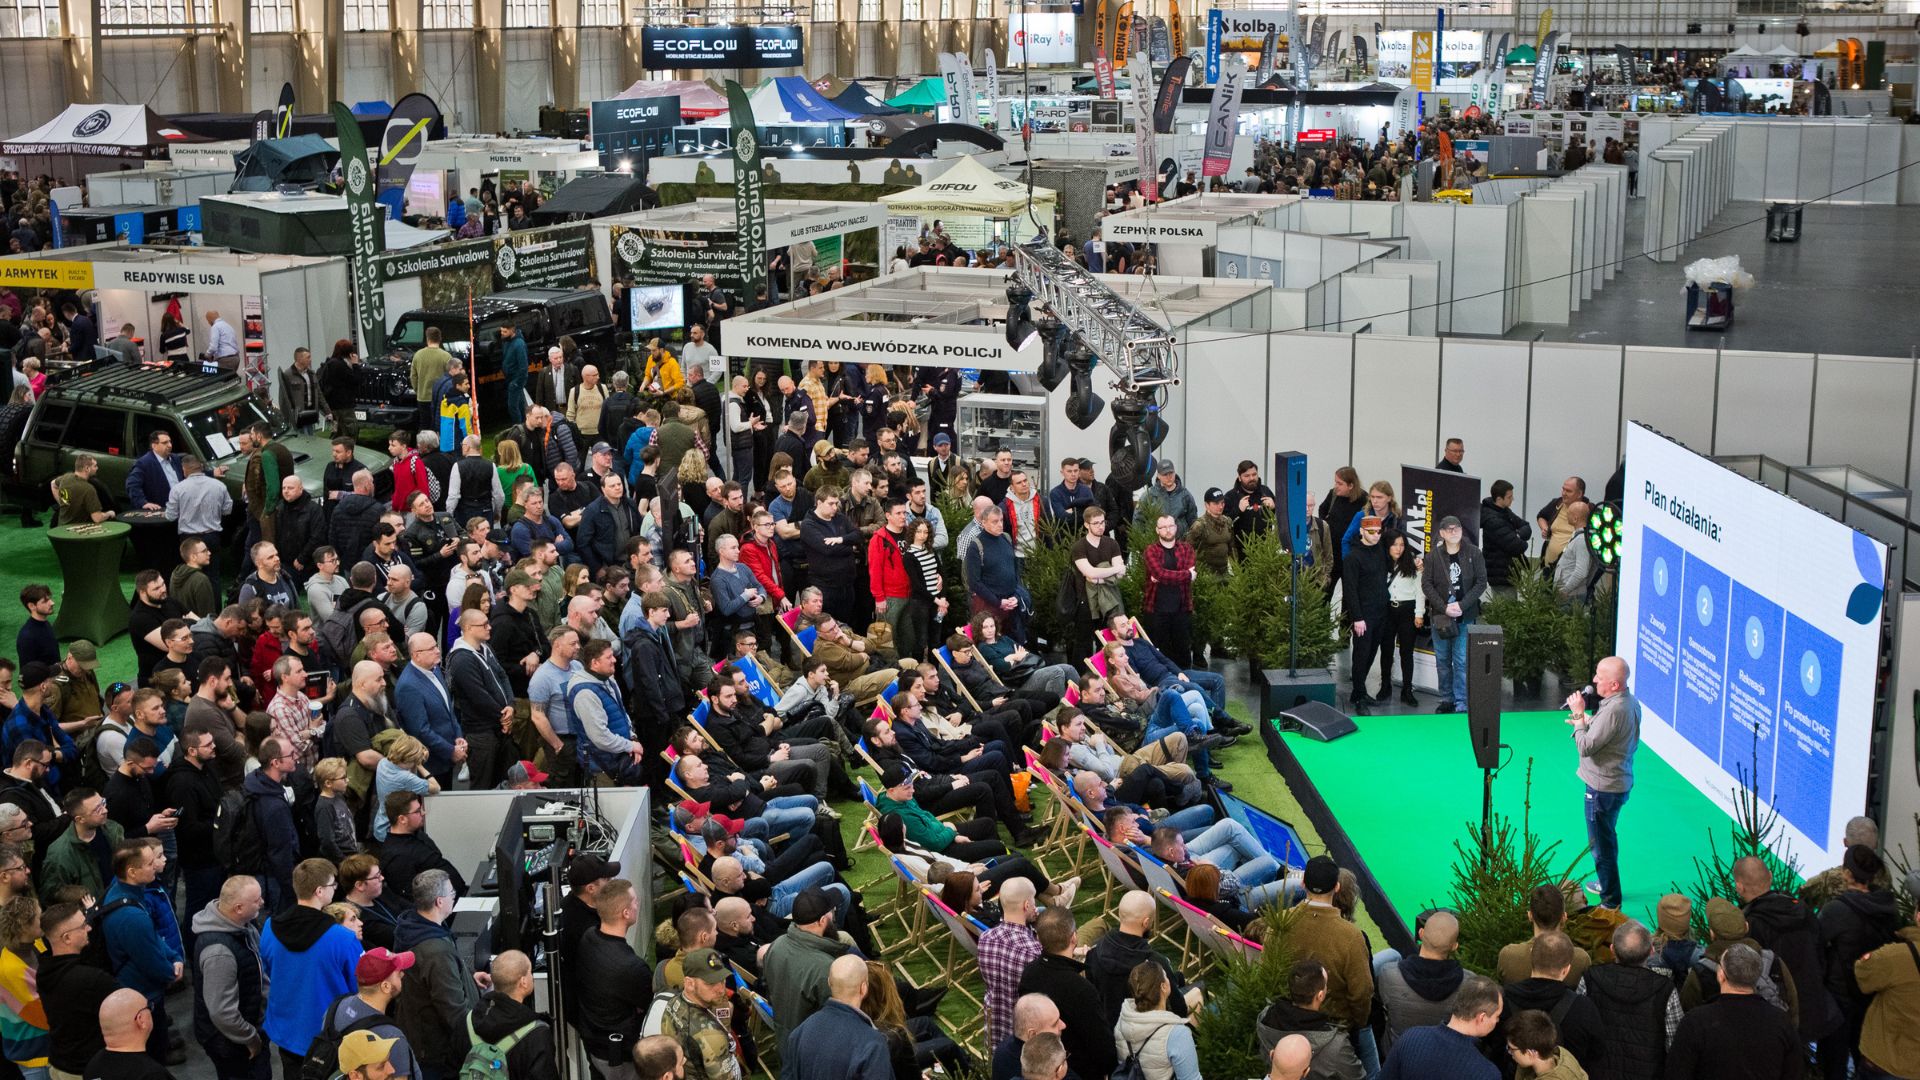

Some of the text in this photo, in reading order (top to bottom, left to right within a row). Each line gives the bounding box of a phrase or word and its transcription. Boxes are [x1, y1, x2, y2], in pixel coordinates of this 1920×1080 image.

[1233, 19, 1288, 33] kolba.pl
[653, 39, 737, 51] ECOFLOW
[755, 38, 798, 51] ECOFLOW
[1029, 34, 1052, 46] iRay
[616, 106, 659, 119] ECOFLOW
[1035, 110, 1067, 118] PARD
[1399, 98, 1409, 130] ubertus
[97, 147, 121, 155] POMOC
[489, 155, 523, 163] HUBSTER
[929, 183, 978, 191] DIFOU
[790, 215, 869, 237] KLUB STRZELAJĄCYCH INACZEJ
[1113, 226, 1204, 237] ZEPHYR POLSKA
[397, 249, 490, 274] Szkolenia Survivalowe
[519, 247, 586, 268] Szkolenia Survivalowe
[650, 248, 696, 259] Szkolenia
[697, 250, 739, 261] Survivalo
[650, 261, 683, 269] Zajmujemy
[693, 261, 727, 270] szkoleniami
[5, 267, 58, 280] ARMYTEK
[124, 271, 225, 286] READYWISE USA
[747, 336, 1002, 359] KOMENDA WOJEWÓDZKA POLICJI
[1424, 489, 1434, 533] libertate
[1644, 479, 1723, 543] Plan działania:
[1658, 569, 1663, 585] 1
[1702, 597, 1708, 615] 2
[1751, 629, 1758, 648] 3
[1806, 665, 1814, 684] 4
[1785, 699, 1793, 715] Po
